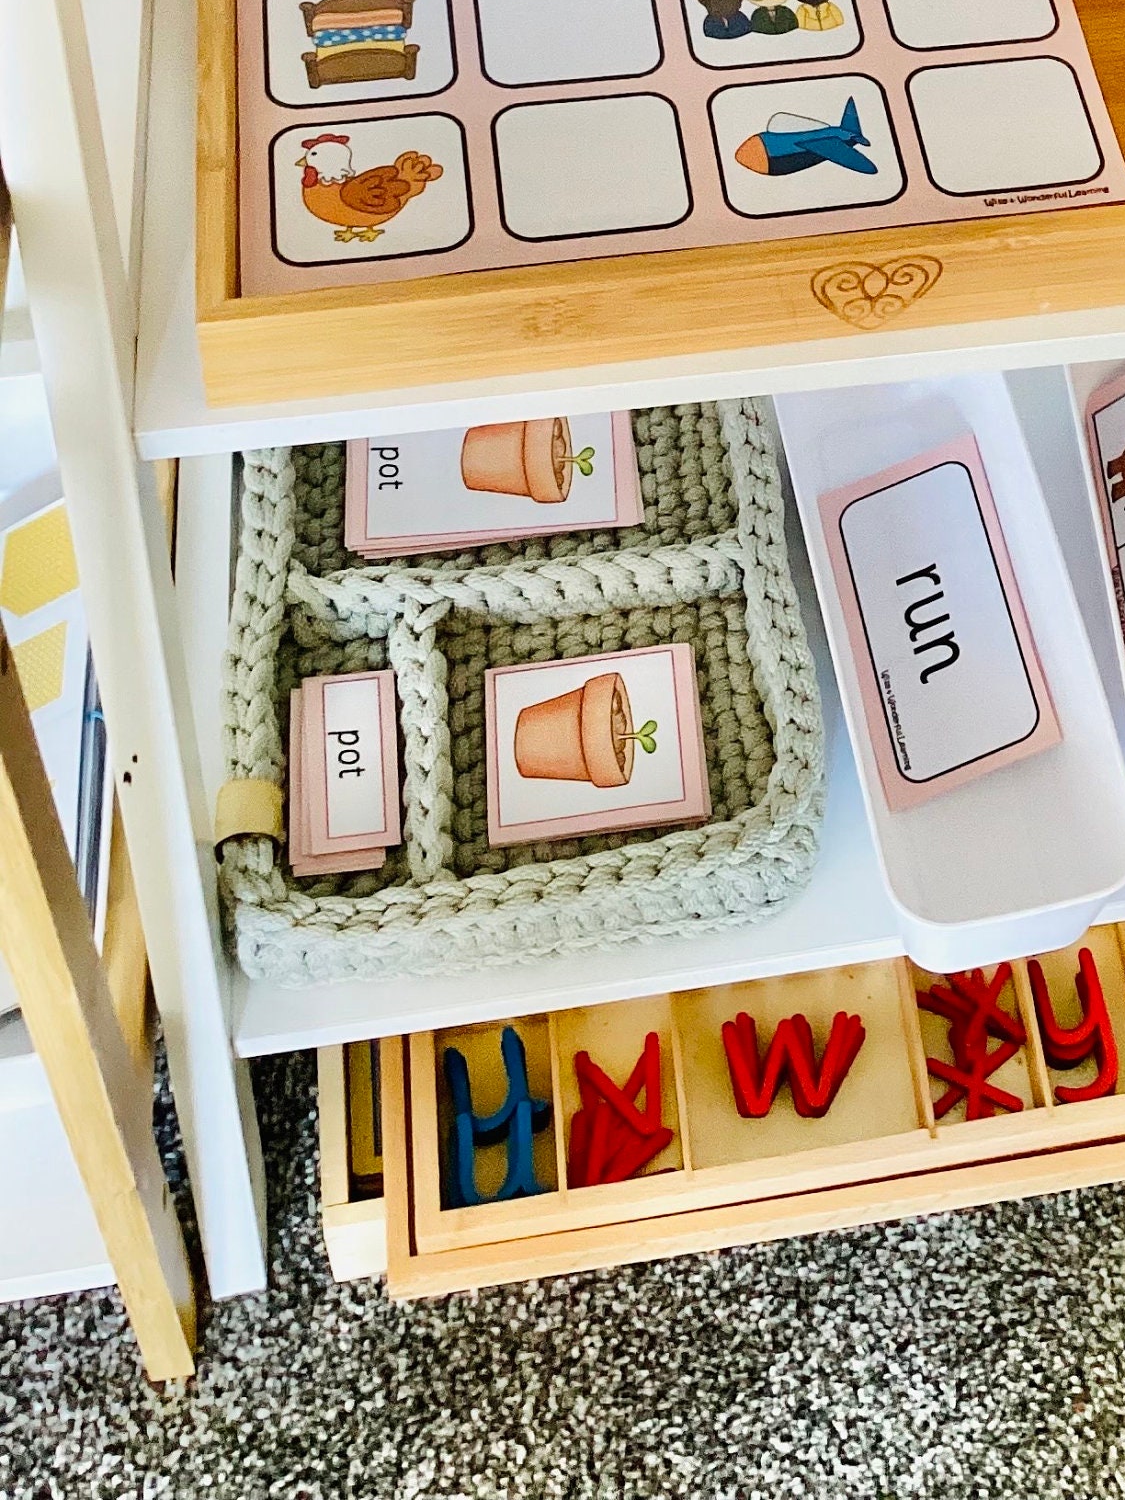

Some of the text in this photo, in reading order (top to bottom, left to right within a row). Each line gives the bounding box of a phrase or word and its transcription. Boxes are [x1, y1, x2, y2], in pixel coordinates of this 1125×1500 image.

[1067, 186, 1110, 199] Learning
[370, 446, 404, 491] pot
[895, 562, 961, 685] run
[327, 729, 366, 779] pot
